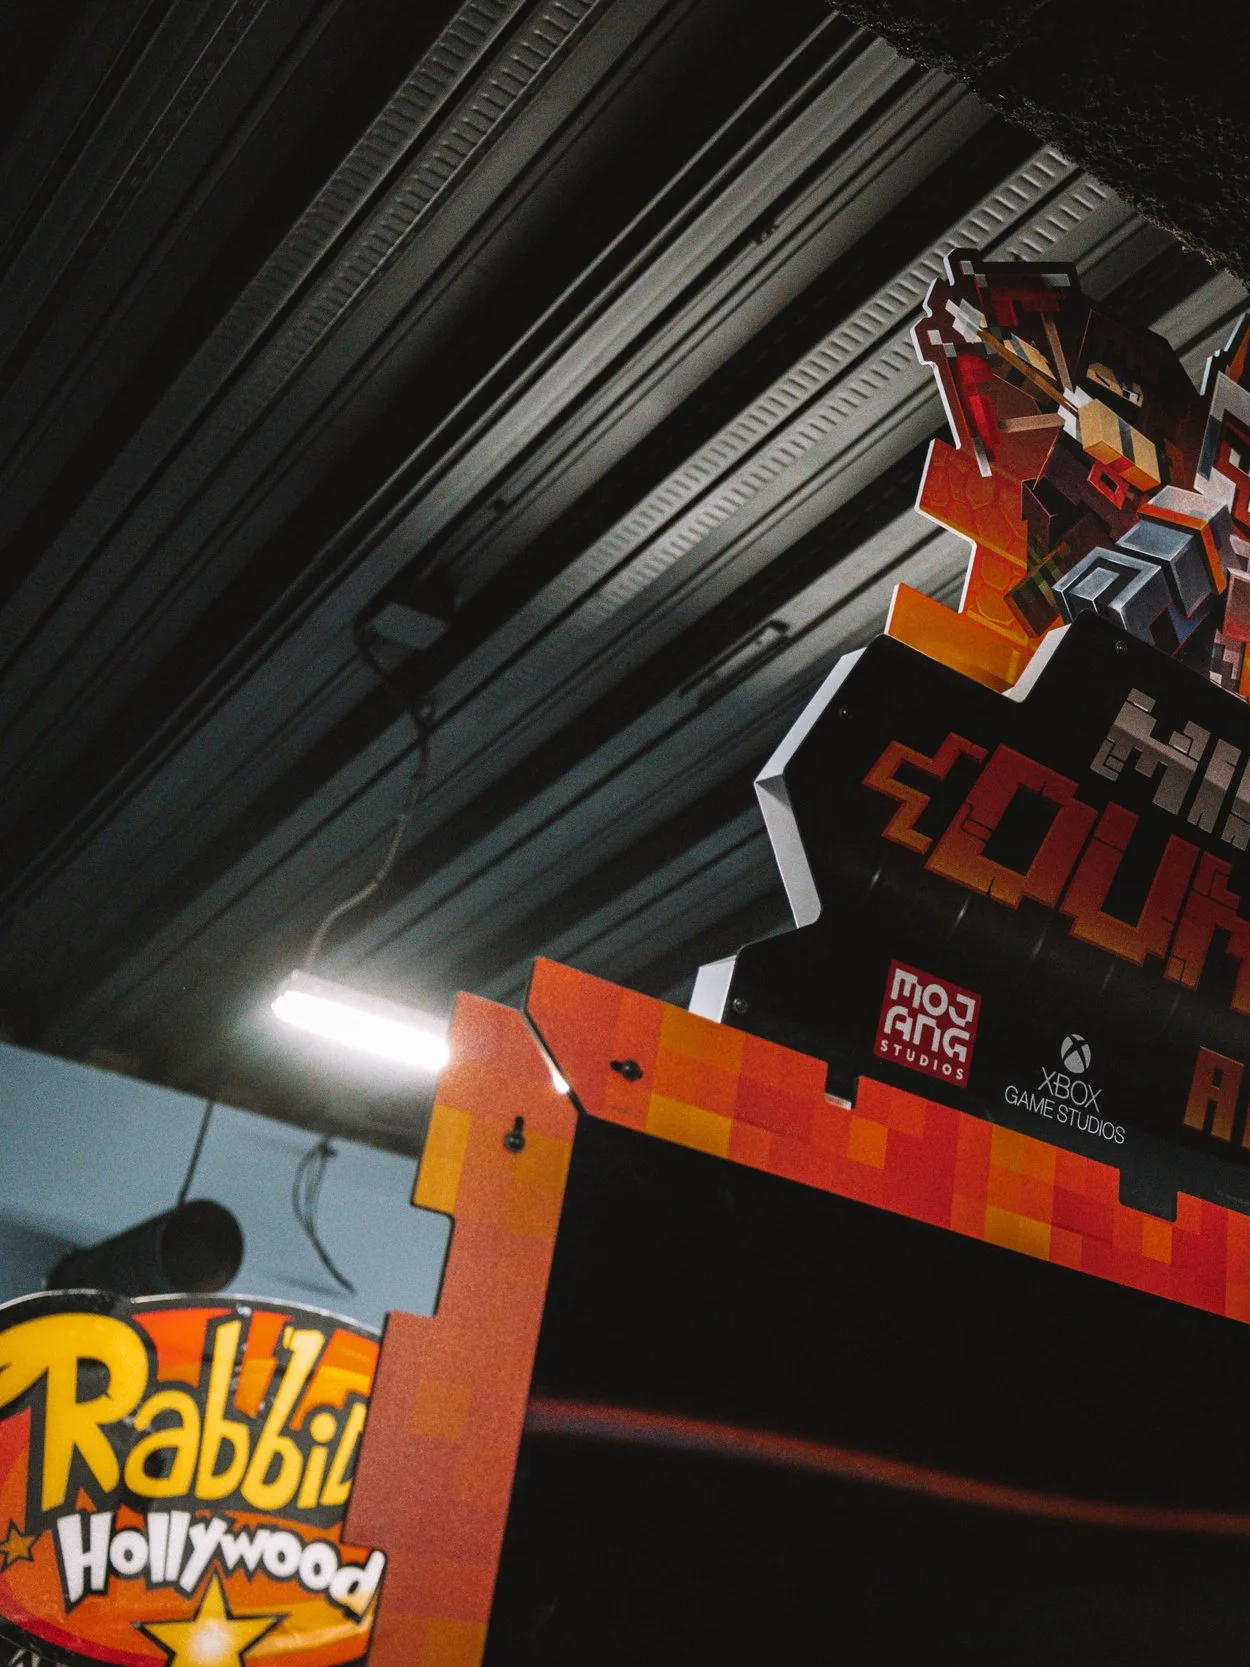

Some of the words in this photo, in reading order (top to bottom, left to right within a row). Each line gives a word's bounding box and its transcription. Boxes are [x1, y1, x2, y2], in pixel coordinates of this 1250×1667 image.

[880, 1039, 964, 1080] STUDIOS
[1004, 1085, 1054, 1119] GAME
[1057, 1104, 1125, 1144] STUDIOS
[1038, 1066, 1102, 1112] XBOX
[57, 1511, 387, 1617] Hollywood
